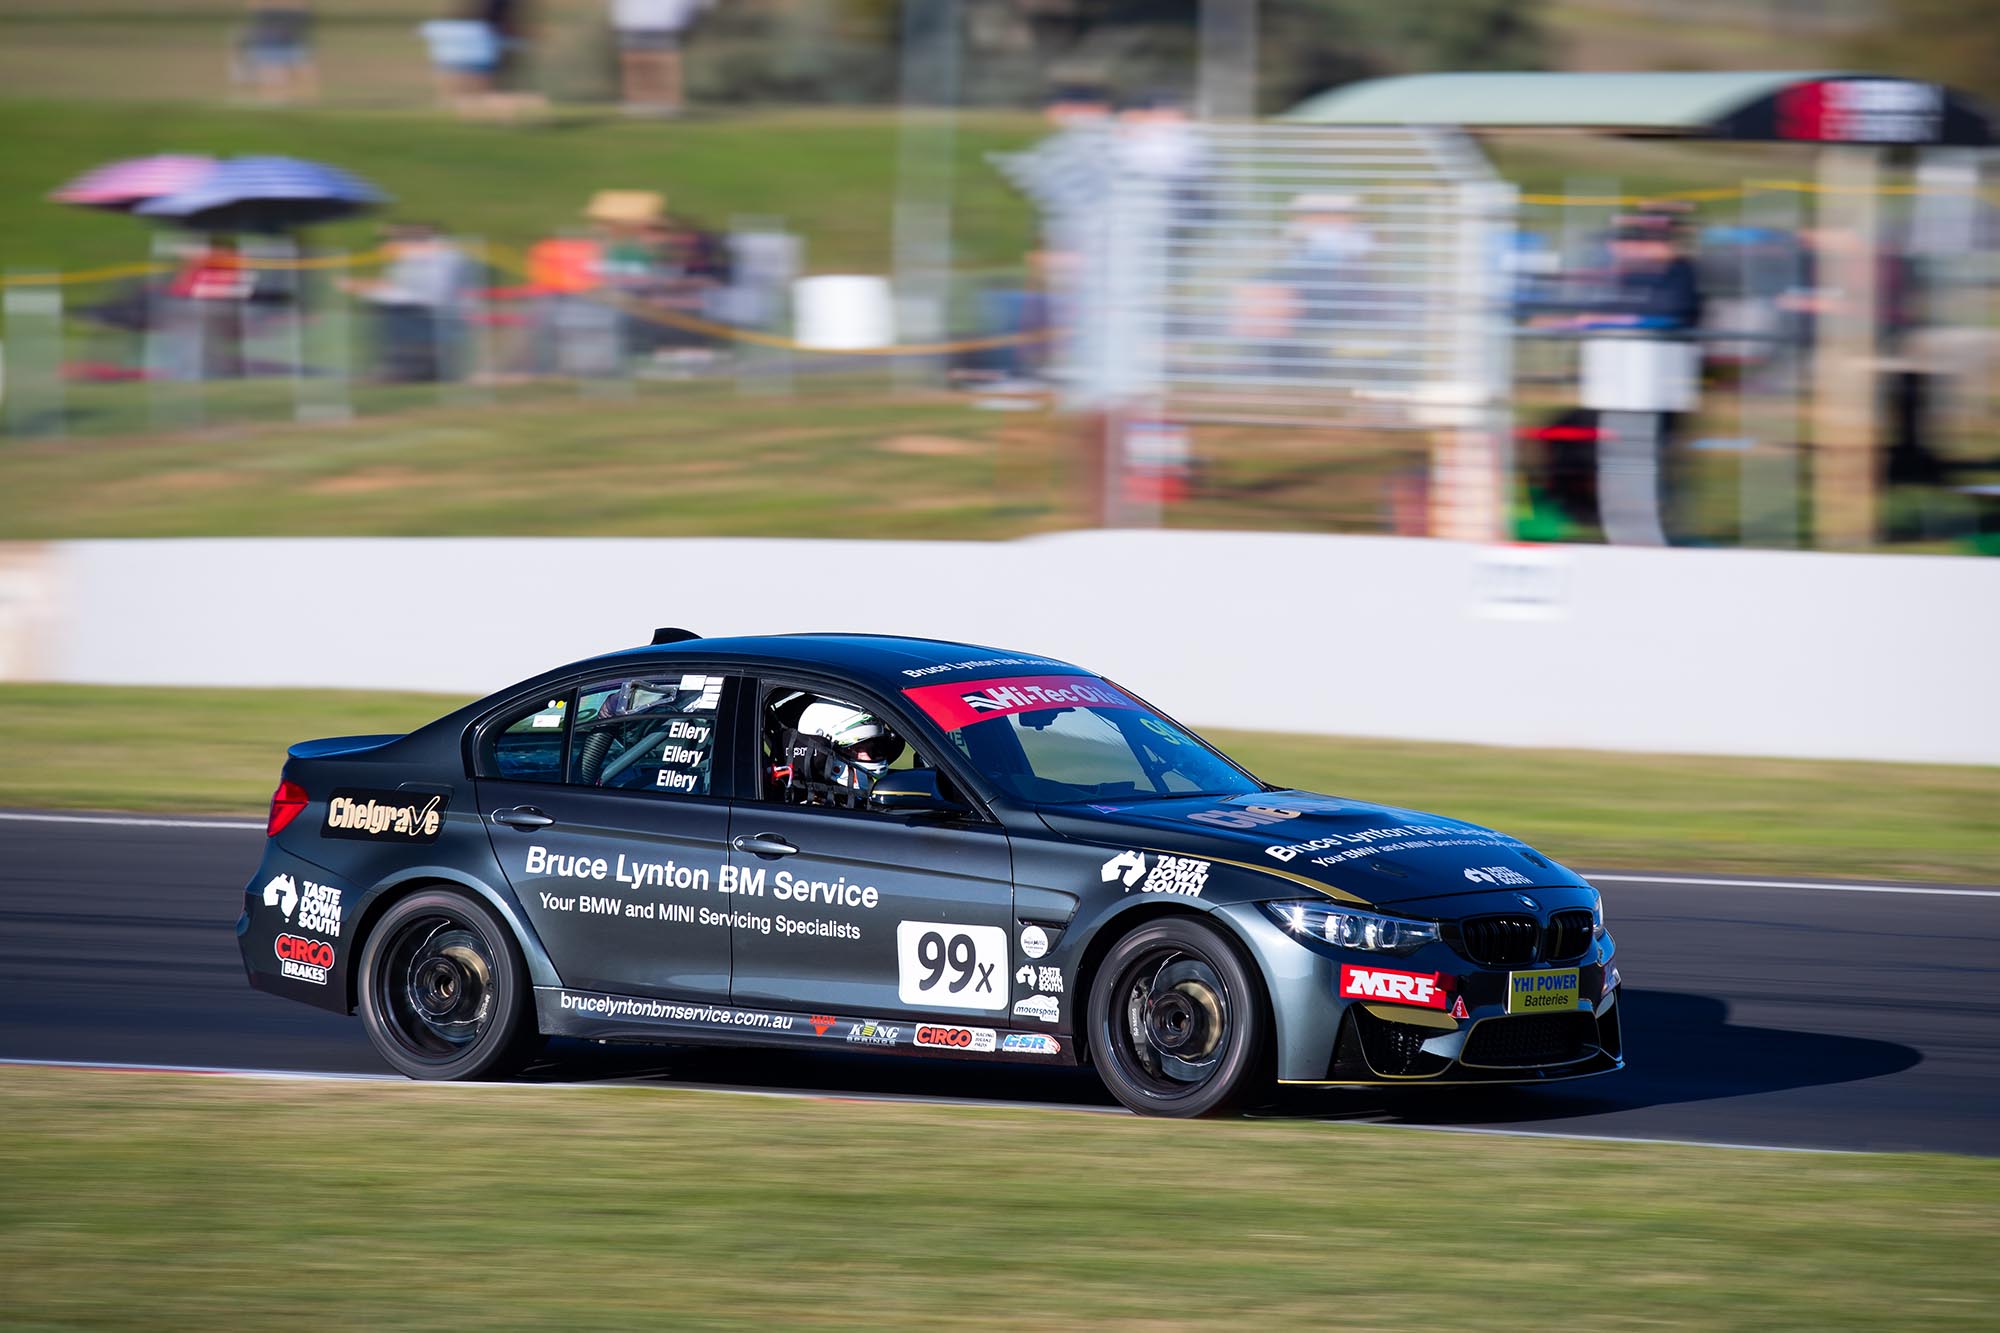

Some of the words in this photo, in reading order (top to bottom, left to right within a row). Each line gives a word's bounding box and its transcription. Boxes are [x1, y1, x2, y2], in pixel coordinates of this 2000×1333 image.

[902, 664, 950, 678] Bruce
[986, 686, 1078, 708] Hi-Tec
[669, 721, 710, 743] Ellery
[662, 745, 703, 767] Ellery
[656, 769, 697, 792] Ellery
[328, 796, 440, 836] Chelgrave
[1265, 838, 1342, 862] Bruce
[1332, 828, 1415, 842] Lynton
[1311, 854, 1347, 867] Your
[1341, 845, 1380, 859] BMW
[1157, 855, 1211, 873] TASTE
[525, 845, 608, 880] Bruce
[616, 853, 709, 890] Lynton
[718, 864, 766, 897] BM
[773, 870, 879, 909] Service
[1148, 867, 1209, 885] DOWN
[303, 881, 342, 905] TASTE
[1141, 879, 1203, 897] SOUTH
[300, 898, 341, 921] DOWN
[539, 891, 576, 912] Your
[579, 895, 622, 916] BMW
[625, 902, 654, 919] and
[658, 903, 695, 923] MINI
[699, 907, 771, 935] Servicing
[775, 915, 861, 940] Specialists
[298, 912, 340, 937] SOUTH
[276, 935, 333, 968] CIRCO
[284, 961, 325, 982] BRAKES
[1346, 969, 1434, 1002] MRF
[1513, 977, 1534, 992] YHI
[1537, 974, 1577, 991] POWER
[560, 991, 793, 1030] brucelyntonbmservice.com.au
[1524, 994, 1568, 1006] Batteries
[917, 1026, 972, 1047] CIRCO
